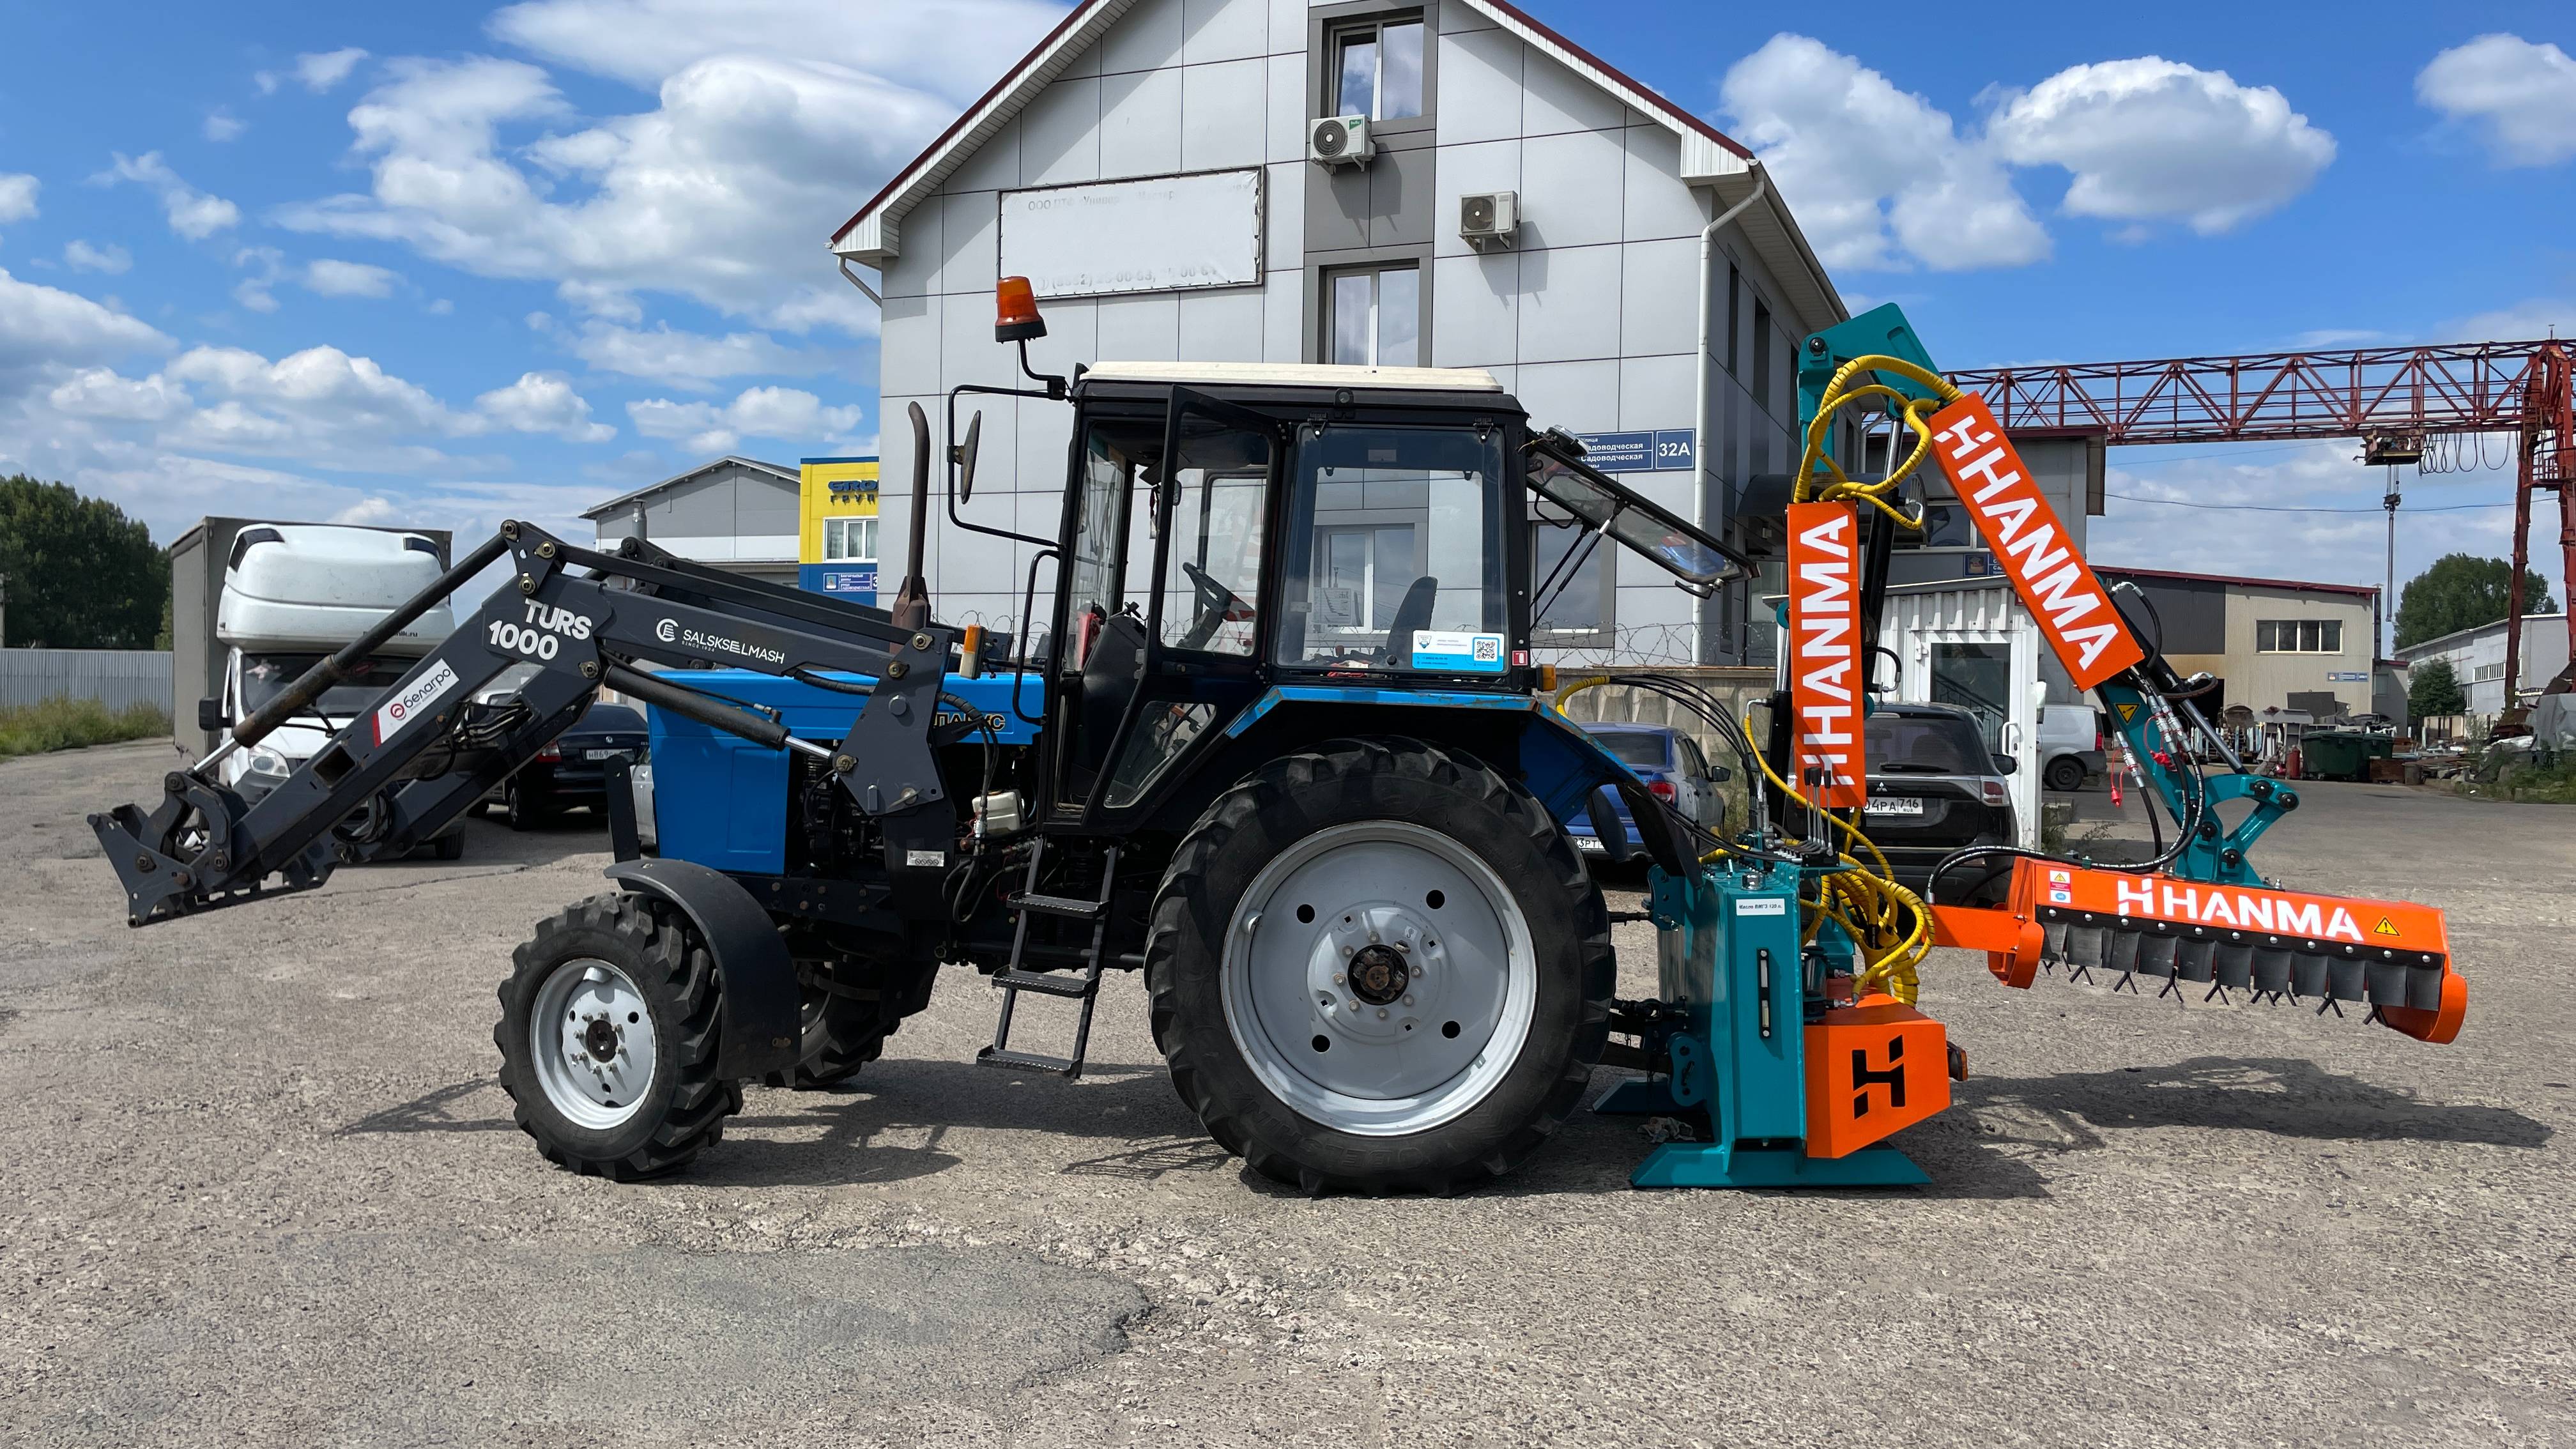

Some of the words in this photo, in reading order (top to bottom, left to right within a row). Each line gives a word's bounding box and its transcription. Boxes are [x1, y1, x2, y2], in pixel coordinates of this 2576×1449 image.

[1659, 442, 1691, 457] 32А
[1957, 446, 2119, 671] HANMA
[525, 598, 592, 640] TURS
[1799, 515, 1852, 745] HANMA
[488, 620, 558, 660] 1000
[683, 629, 785, 664] SALSKSELMASH
[403, 669, 451, 709] белагро
[1898, 798, 1919, 808] 716
[2163, 885, 2365, 942] HANMA
